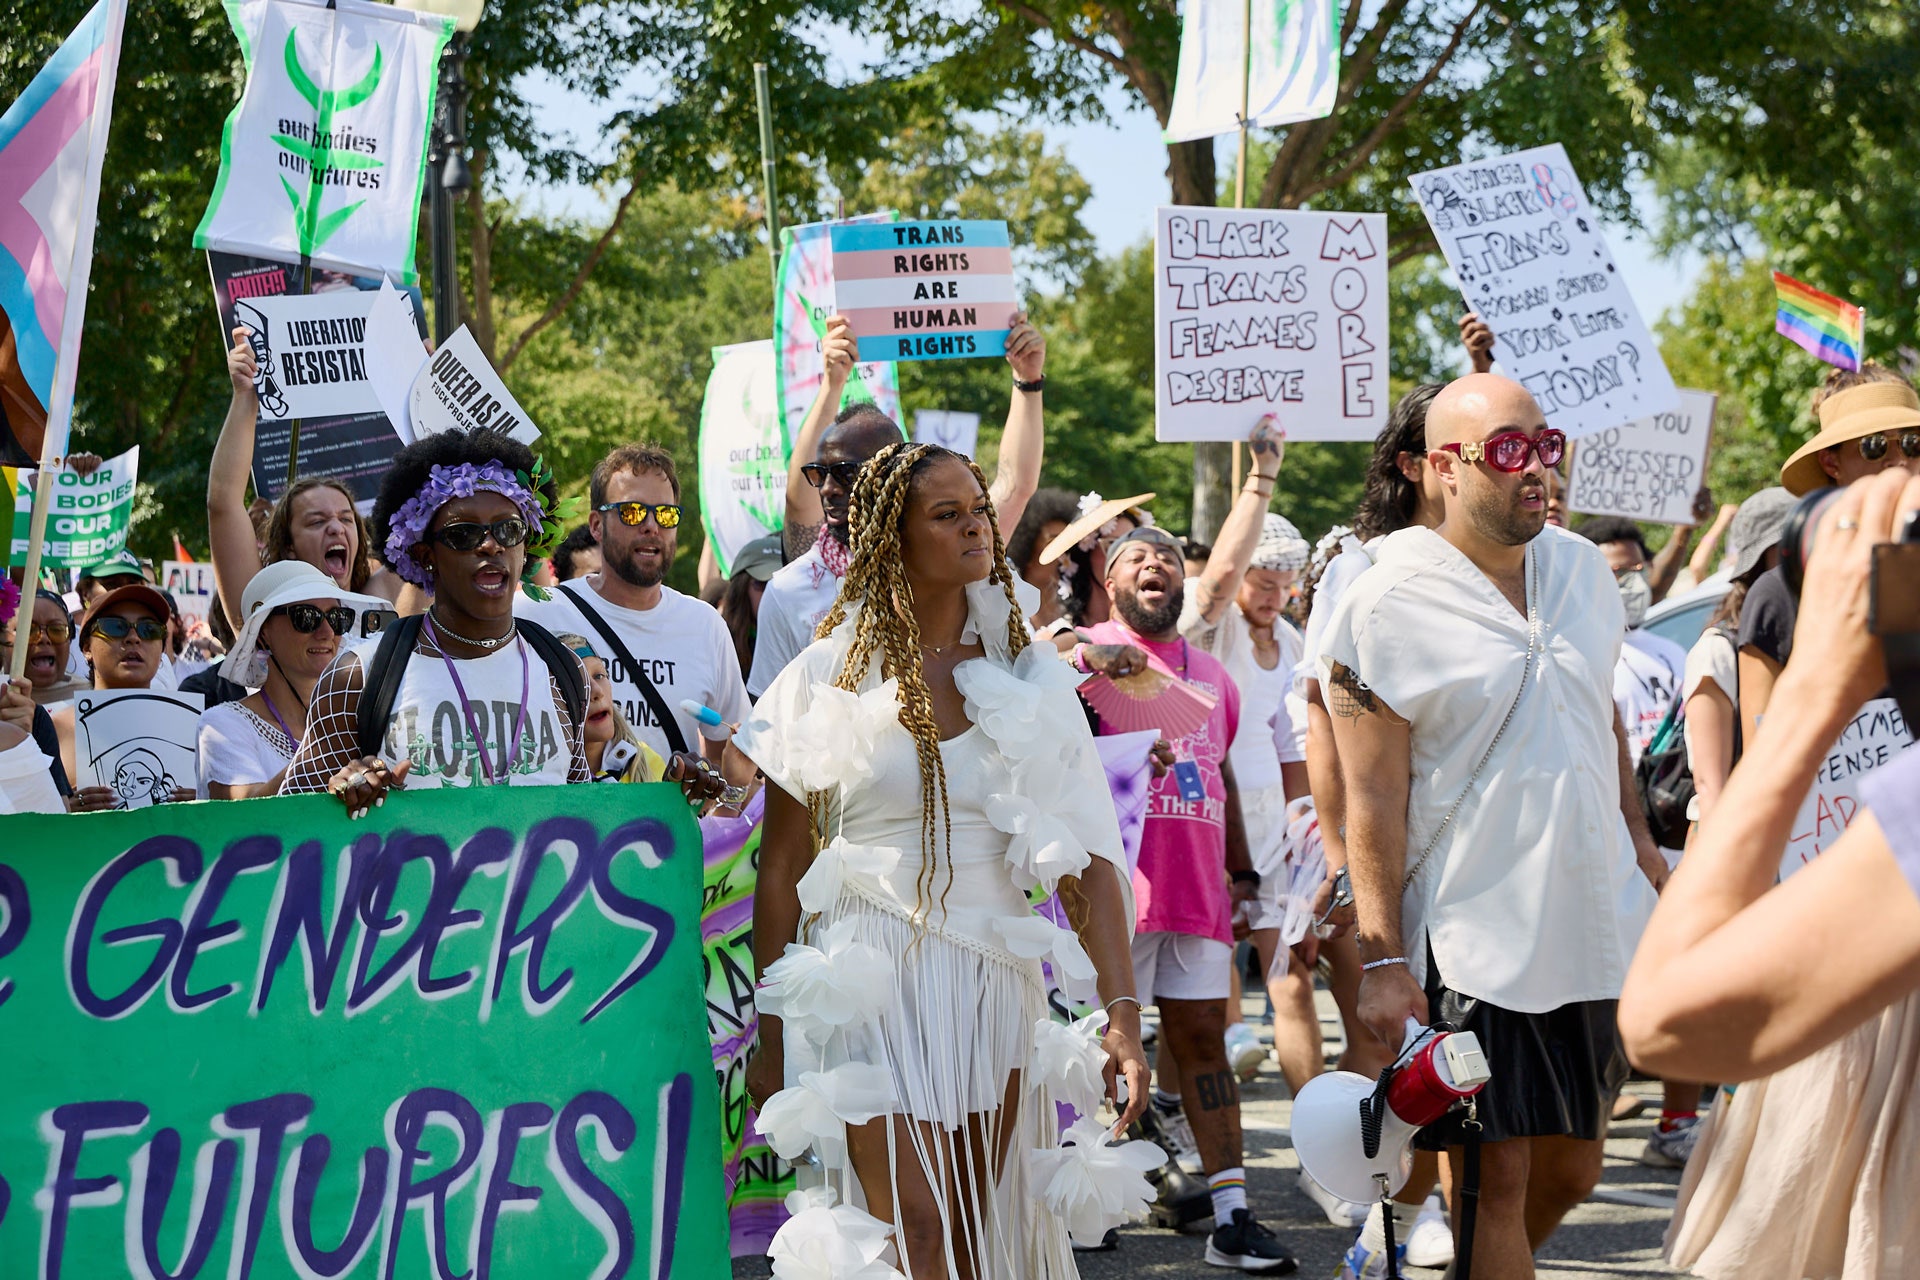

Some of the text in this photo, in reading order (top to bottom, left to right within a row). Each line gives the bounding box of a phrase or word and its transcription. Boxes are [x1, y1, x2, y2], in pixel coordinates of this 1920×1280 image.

[278, 118, 377, 154] our bodies
[279, 151, 306, 175] our
[1453, 163, 1527, 194] WHICH
[1457, 190, 1542, 227] BLACK
[893, 225, 965, 245] TRANS
[1168, 215, 1290, 260] BLACK
[1455, 221, 1571, 276] TRANS
[894, 253, 970, 273] RIGHTS
[913, 281, 959, 300] ARE
[1166, 264, 1307, 310] TRANS
[1473, 272, 1609, 321] WOMAN SAVED
[893, 308, 977, 329] HUMAN
[1319, 217, 1378, 418] MORE
[1498, 307, 1625, 359] YOUR LIFE
[898, 335, 977, 356] RIGHTS
[1170, 311, 1319, 359] FEMMES
[430, 348, 520, 434] QUEER AS IN
[431, 381, 450, 406] FUCK
[1167, 365, 1304, 406] DESERVE
[1520, 340, 1643, 417] TODAY?
[1653, 413, 1692, 435] YOU
[729, 448, 750, 462] our
[1582, 447, 1695, 479] OBSESSED
[57, 479, 133, 508] BODIES
[58, 469, 113, 487] OUR
[731, 477, 751, 491] our
[1578, 466, 1689, 498] WITH OUR
[55, 513, 111, 534] OUR
[167, 568, 209, 595] ALL
[385, 699, 559, 779] FLORIDA
[1159, 794, 1198, 816] THE
[63, 816, 677, 1026] GENDERS
